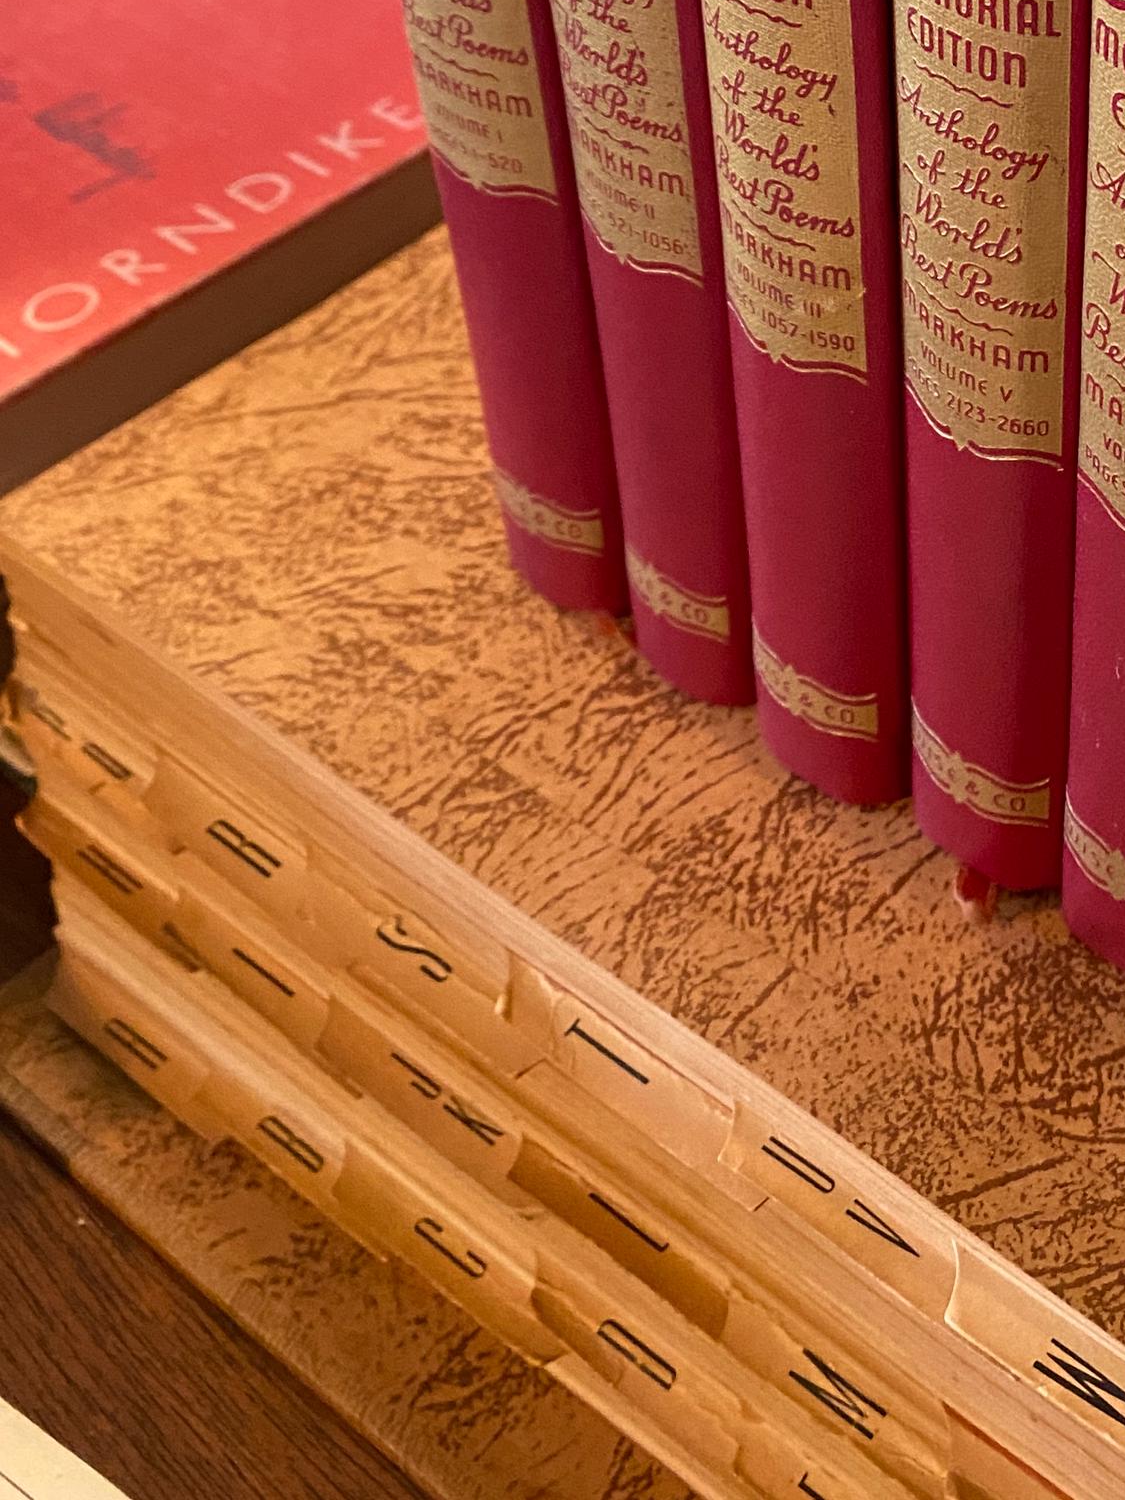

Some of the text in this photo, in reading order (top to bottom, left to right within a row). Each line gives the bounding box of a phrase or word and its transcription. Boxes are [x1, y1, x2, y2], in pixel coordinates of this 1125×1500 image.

[446, 14, 530, 66] Poems
[704, 0, 839, 103] Anthology
[906, 6, 1027, 89] EDITION
[601, 83, 684, 143] Poems
[721, 68, 805, 128] of the
[899, 75, 1050, 183] Anthology
[713, 84, 821, 182] World's
[716, 134, 856, 239] Best Poems
[902, 161, 1023, 264] World's
[917, 149, 1009, 210] of the
[0, 96, 428, 359] ORNDIKE
[607, 211, 684, 256] 521-1056
[720, 200, 852, 292] MARKHAM
[736, 257, 797, 311] VOLUME
[803, 298, 822, 319] III
[900, 212, 1059, 321] Best Poems
[761, 307, 856, 353] 1057-1590
[903, 277, 1050, 374] MARKHAM
[919, 339, 1014, 403] VOLUME V
[946, 391, 1050, 437] 2123-2660
[823, 704, 855, 725] CO
[993, 793, 1026, 813] CO
[206, 818, 282, 879] R
[376, 913, 453, 983] S
[565, 1018, 650, 1085] T
[390, 1051, 505, 1147] J K
[258, 1115, 325, 1174] B
[588, 1191, 670, 1253] L
[761, 1135, 921, 1258] U V
[413, 1216, 488, 1278] C
[596, 1318, 678, 1391] D
[788, 1347, 888, 1440] M
